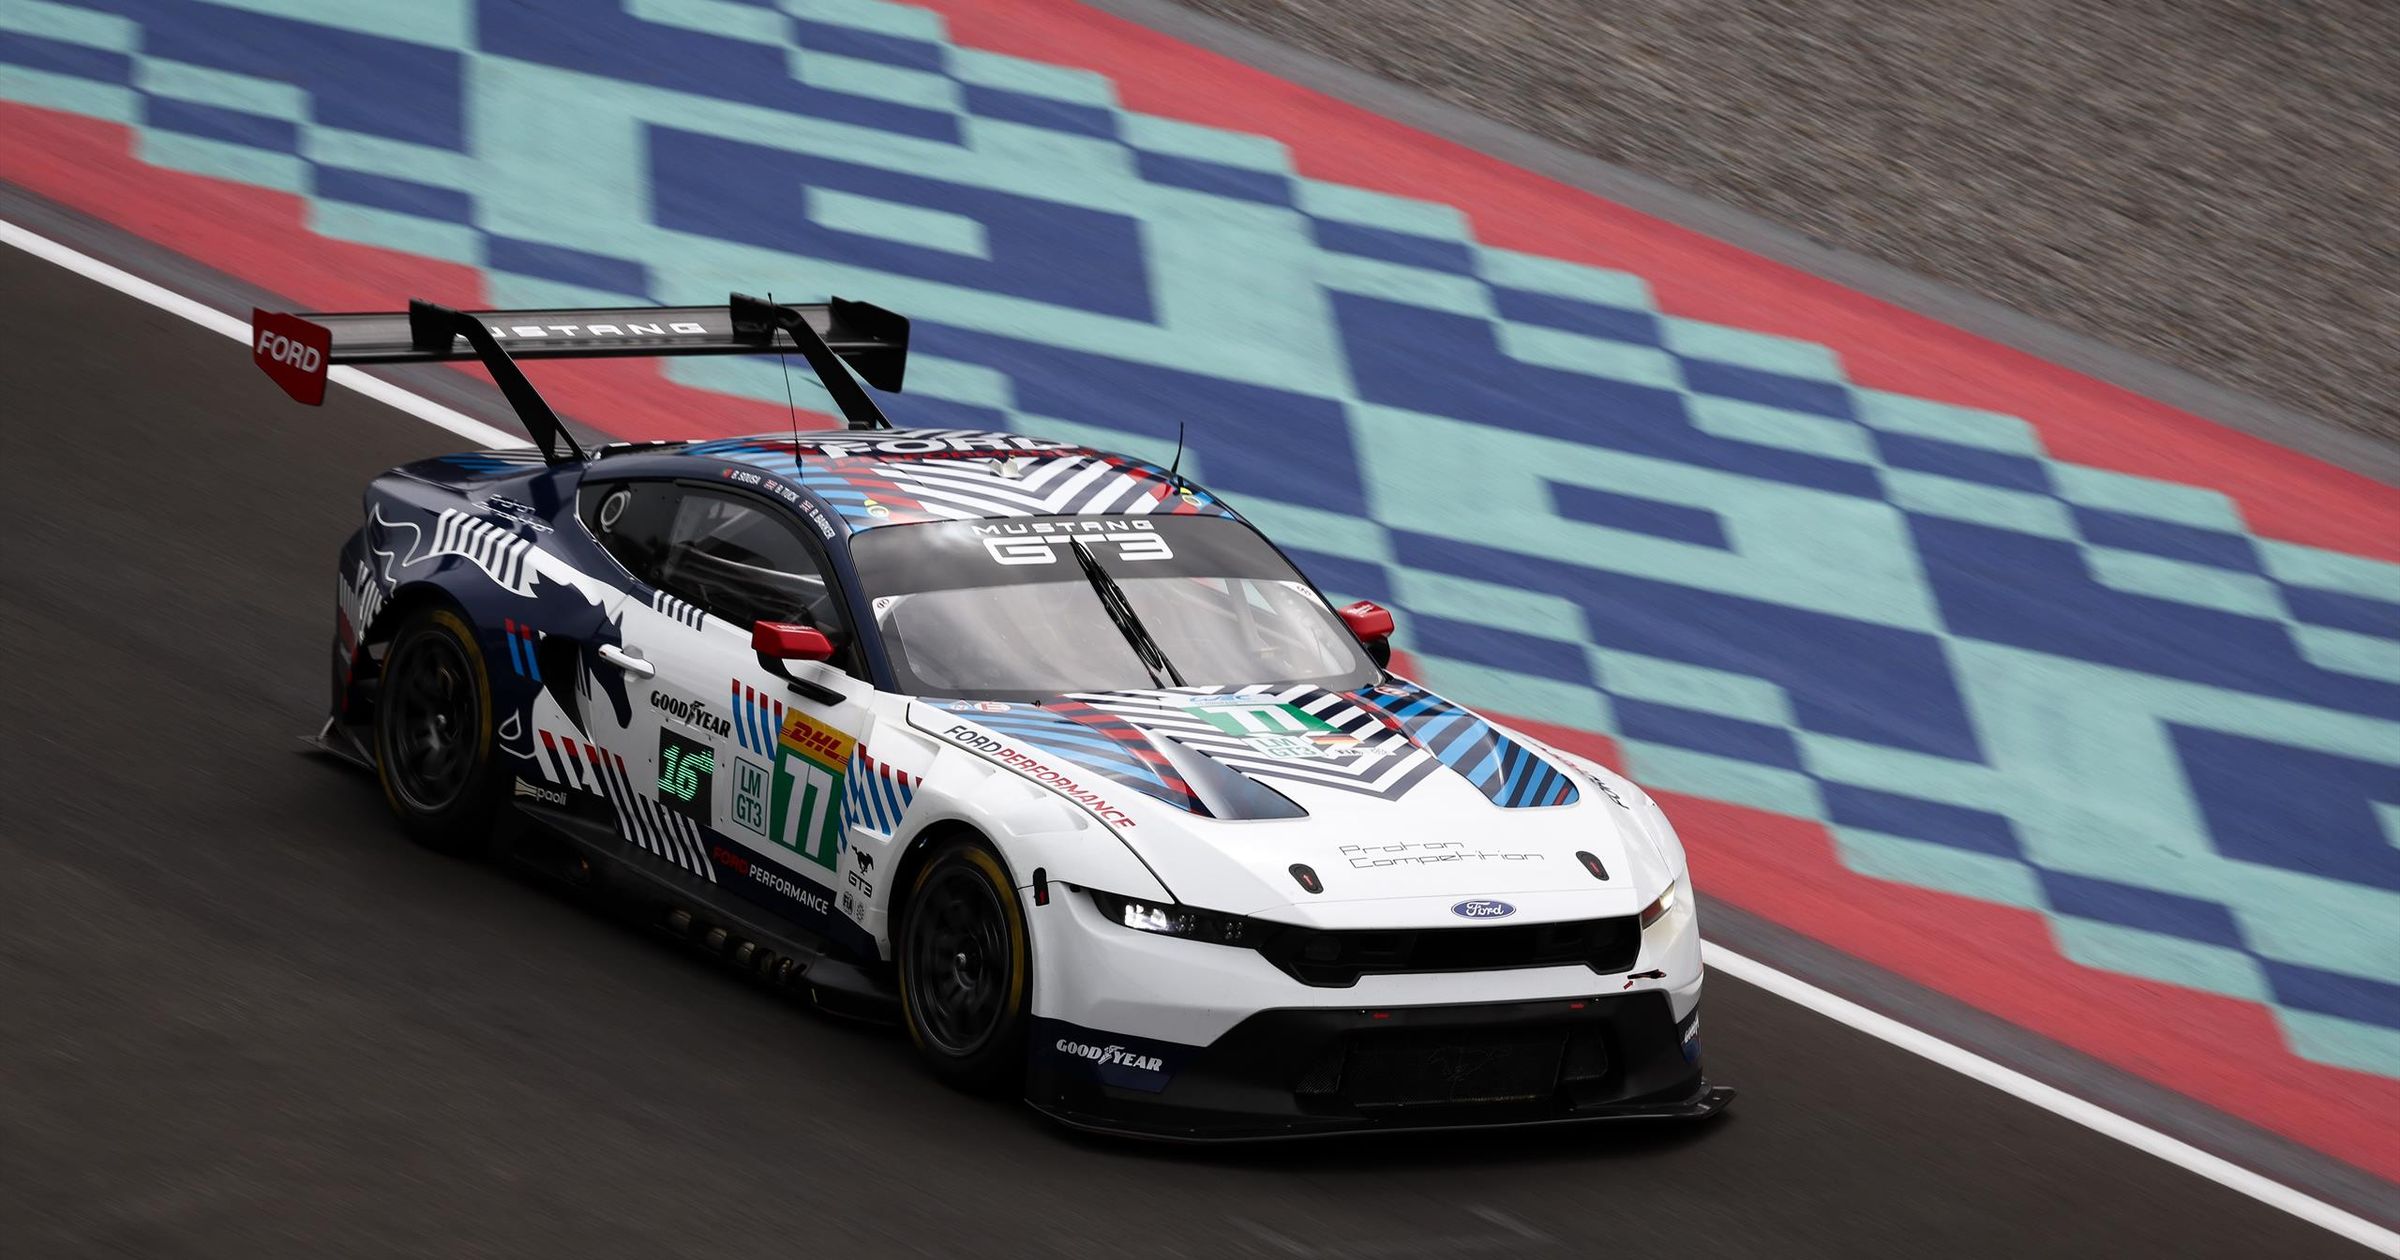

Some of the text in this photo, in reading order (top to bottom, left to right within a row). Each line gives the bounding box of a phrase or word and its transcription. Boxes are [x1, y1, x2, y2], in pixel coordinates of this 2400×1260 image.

[456, 322, 708, 339] STANG
[256, 329, 321, 374] FORD
[819, 437, 1079, 459] FORD
[971, 520, 1154, 536] MUSTANG
[983, 532, 1174, 565] GT3
[650, 690, 731, 739] GOODYEAR
[789, 721, 842, 760] DHL
[740, 766, 762, 799] LM
[944, 725, 1136, 829] FORD PERFORMANCE
[536, 788, 567, 806] paoli
[736, 793, 762, 828] GT3
[783, 753, 833, 858] 77
[1338, 841, 1465, 856] Proton
[1349, 850, 1545, 869] Competition
[712, 846, 829, 916] FORD PERFORMANCE
[848, 869, 873, 899] GT3
[1465, 901, 1504, 917] Ford
[1056, 1039, 1163, 1072] GOODYEAR
